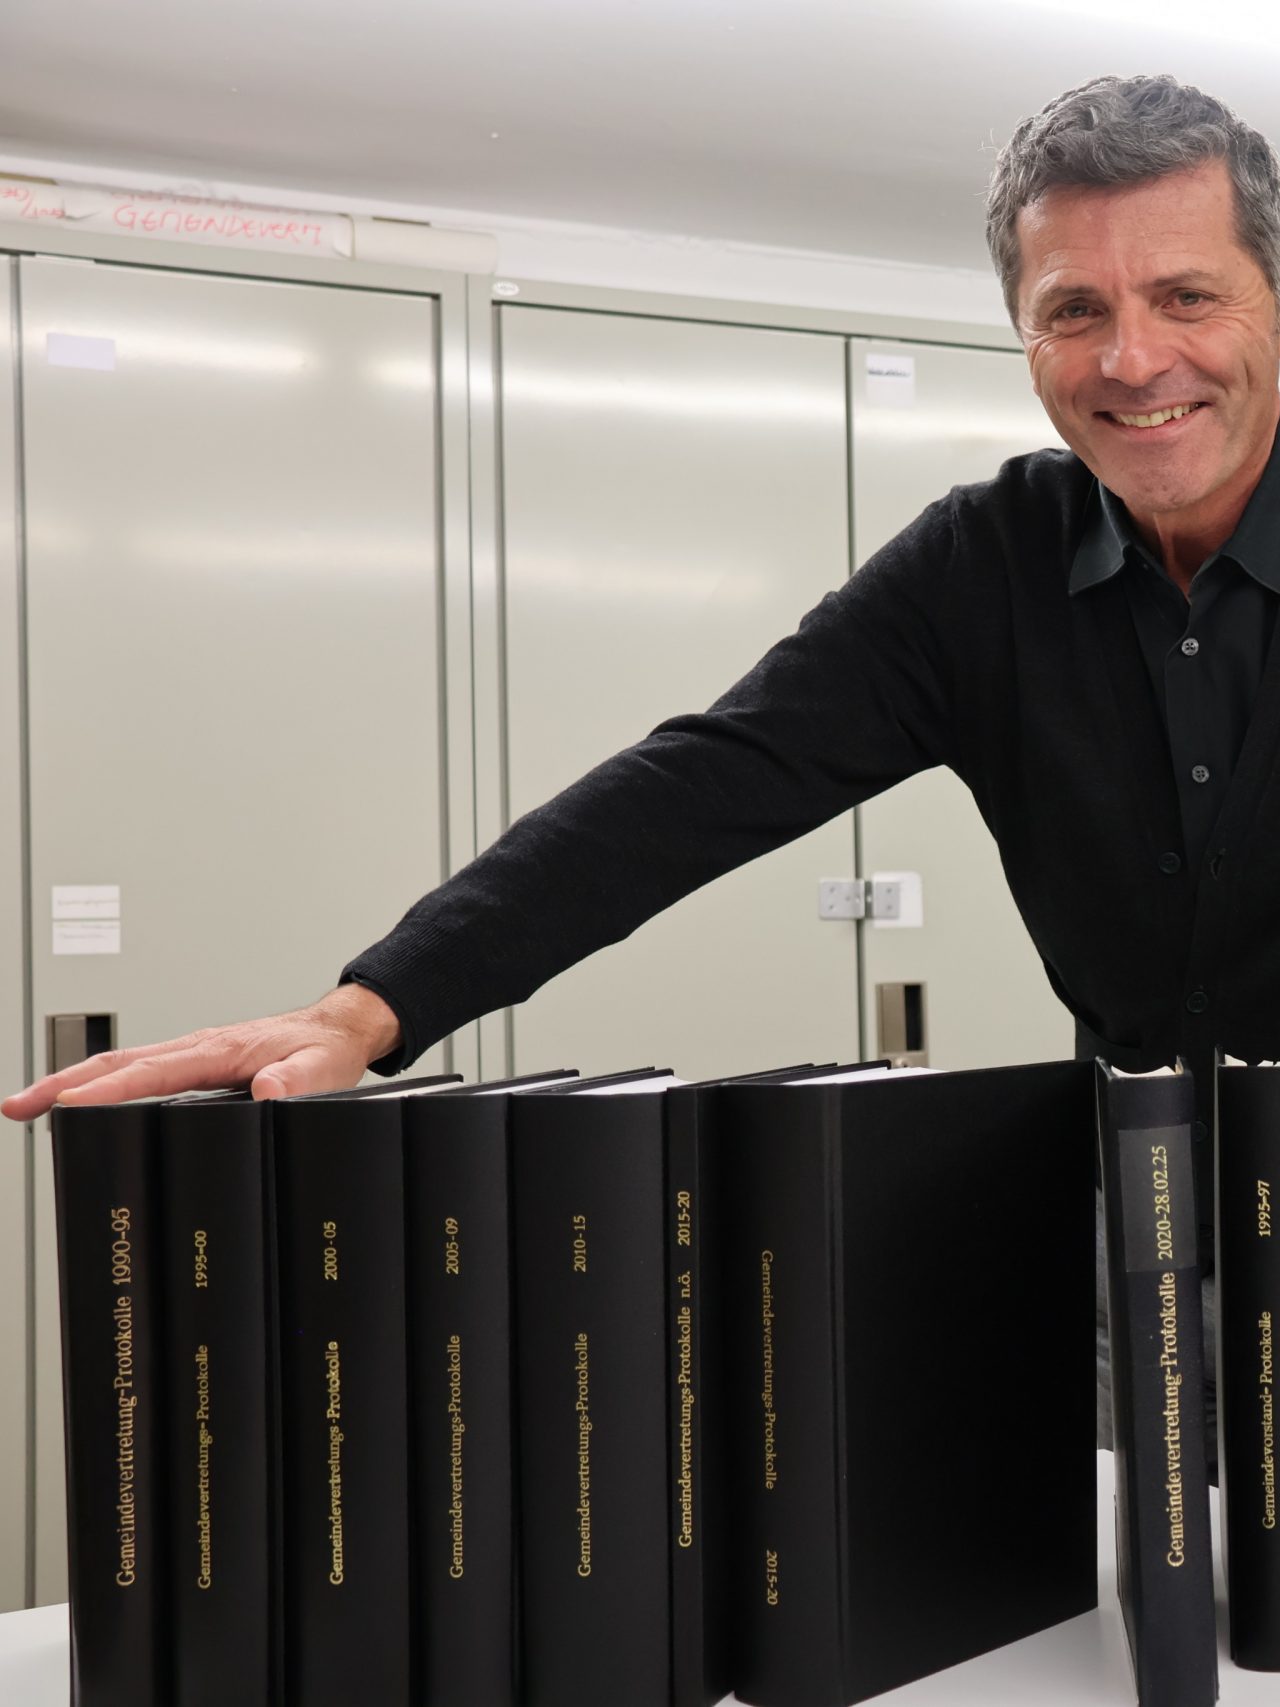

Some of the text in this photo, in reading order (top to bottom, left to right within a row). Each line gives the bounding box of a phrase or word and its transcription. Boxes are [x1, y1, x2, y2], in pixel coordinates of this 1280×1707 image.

[194, 1230, 208, 1288] 1995-00
[677, 1190, 695, 1548] Gemeindevertretungs-Protokolle n.ö. 2015-20
[1151, 1146, 1185, 1568] Gemeindevertretung-Protokolle 2020-28.02.25
[1257, 1180, 1271, 1237] 1995-97
[111, 1207, 138, 1587] Gemeindevertretung-Protokolle 1990-95
[445, 1217, 466, 1579] Gemeindevertretungs-Protokolle 2005-09
[573, 1215, 593, 1577] Gemeindevertretungs-Protokolle 2010-15
[762, 1250, 778, 1606] Gemeindevertretungs-Protokolle 2015-20
